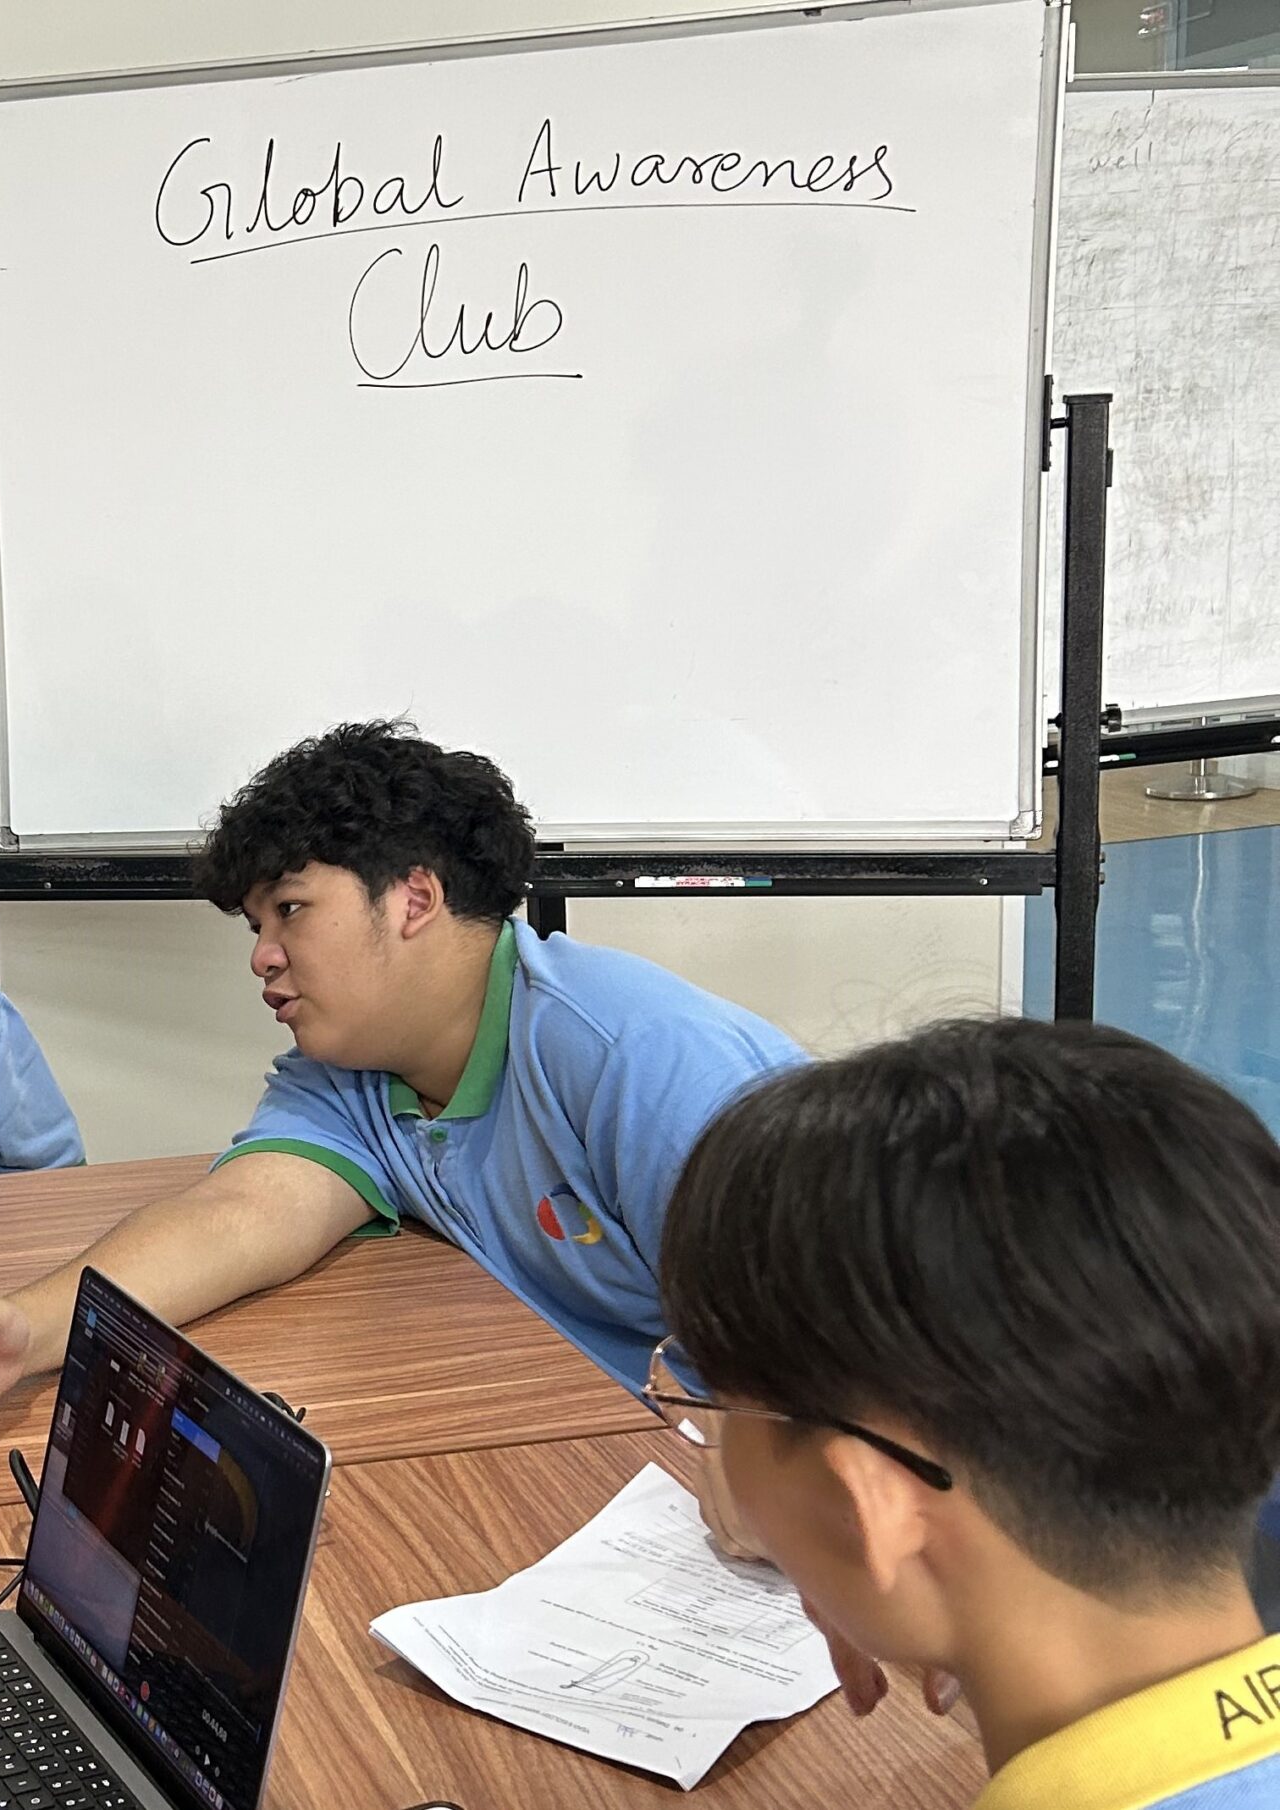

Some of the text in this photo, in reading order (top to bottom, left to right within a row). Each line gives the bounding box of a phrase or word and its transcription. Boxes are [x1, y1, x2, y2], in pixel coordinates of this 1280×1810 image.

[155, 118, 899, 246] Global Awareness
[348, 243, 563, 380] Club
